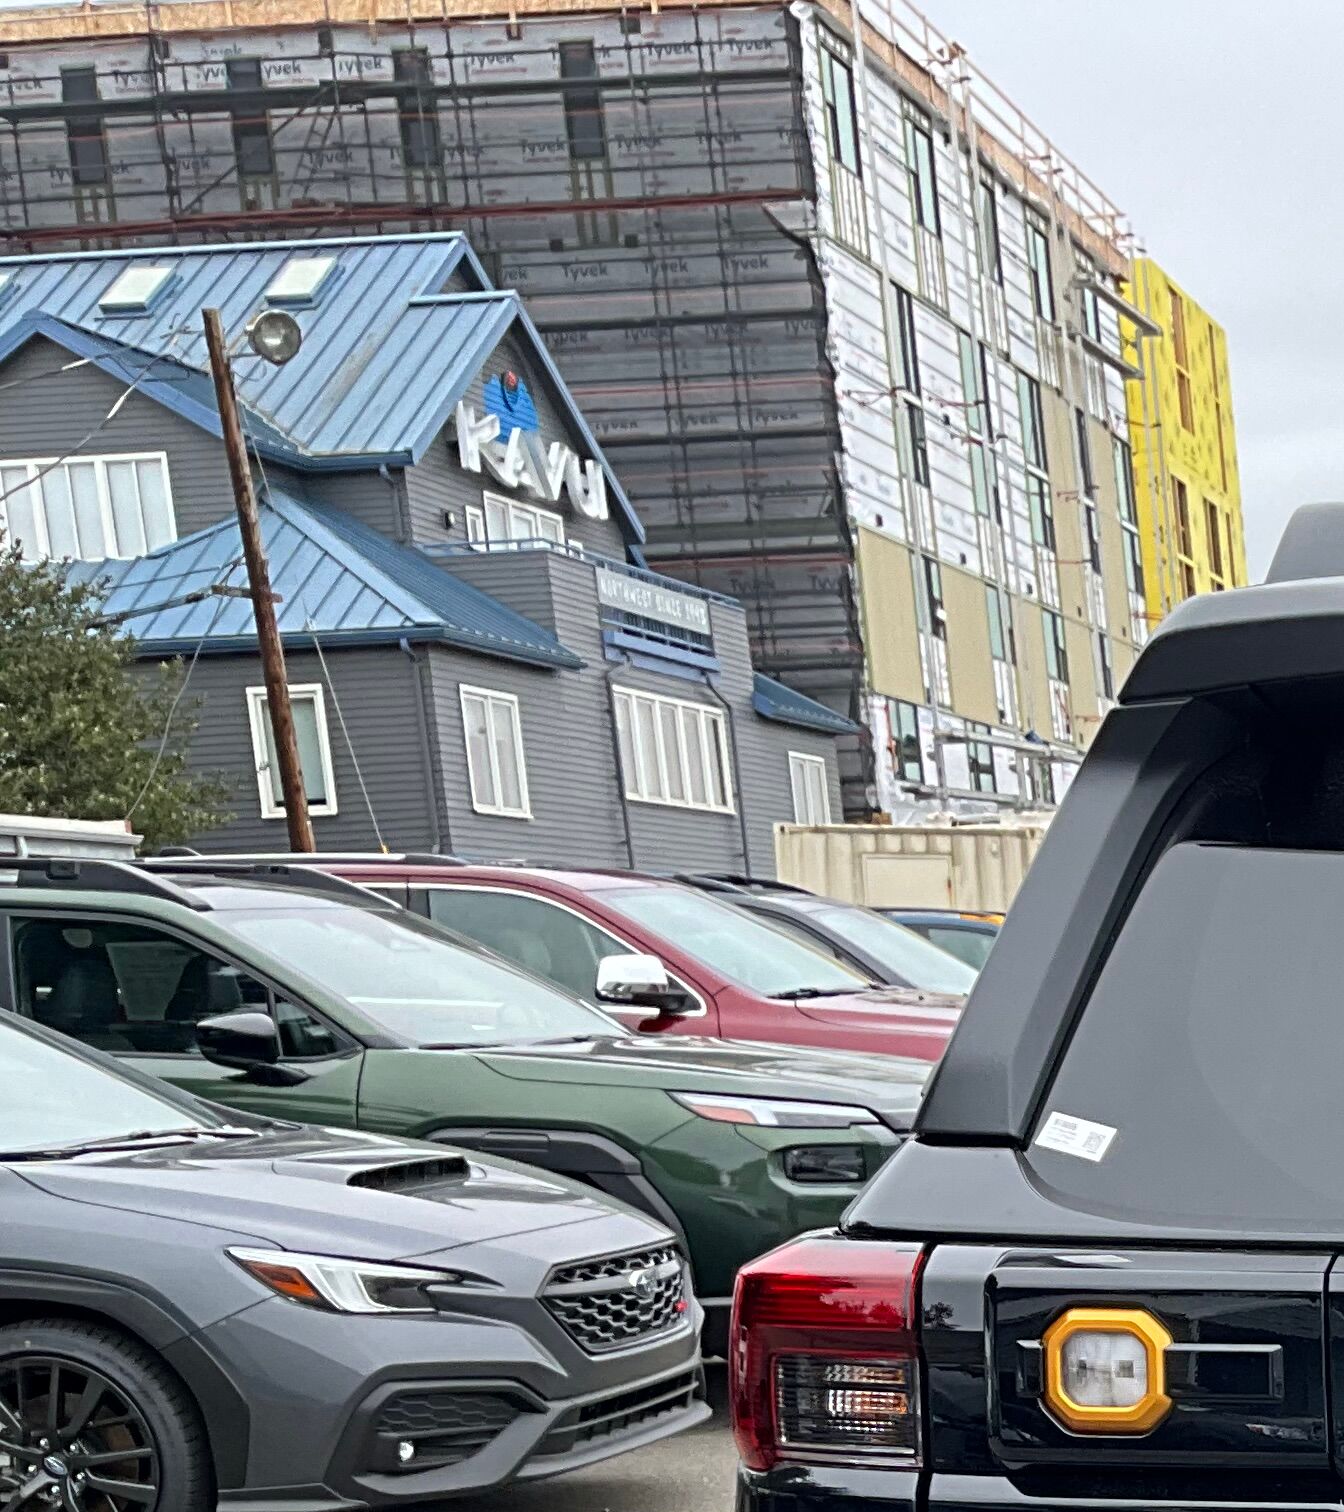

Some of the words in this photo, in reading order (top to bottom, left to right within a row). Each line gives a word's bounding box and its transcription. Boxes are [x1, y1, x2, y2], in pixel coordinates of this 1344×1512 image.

[262, 60, 301, 80] yvek
[561, 261, 608, 282] Tyvek
[641, 255, 689, 278] Tyvek
[722, 250, 769, 274] Tyvek
[456, 400, 608, 520] KAVU
